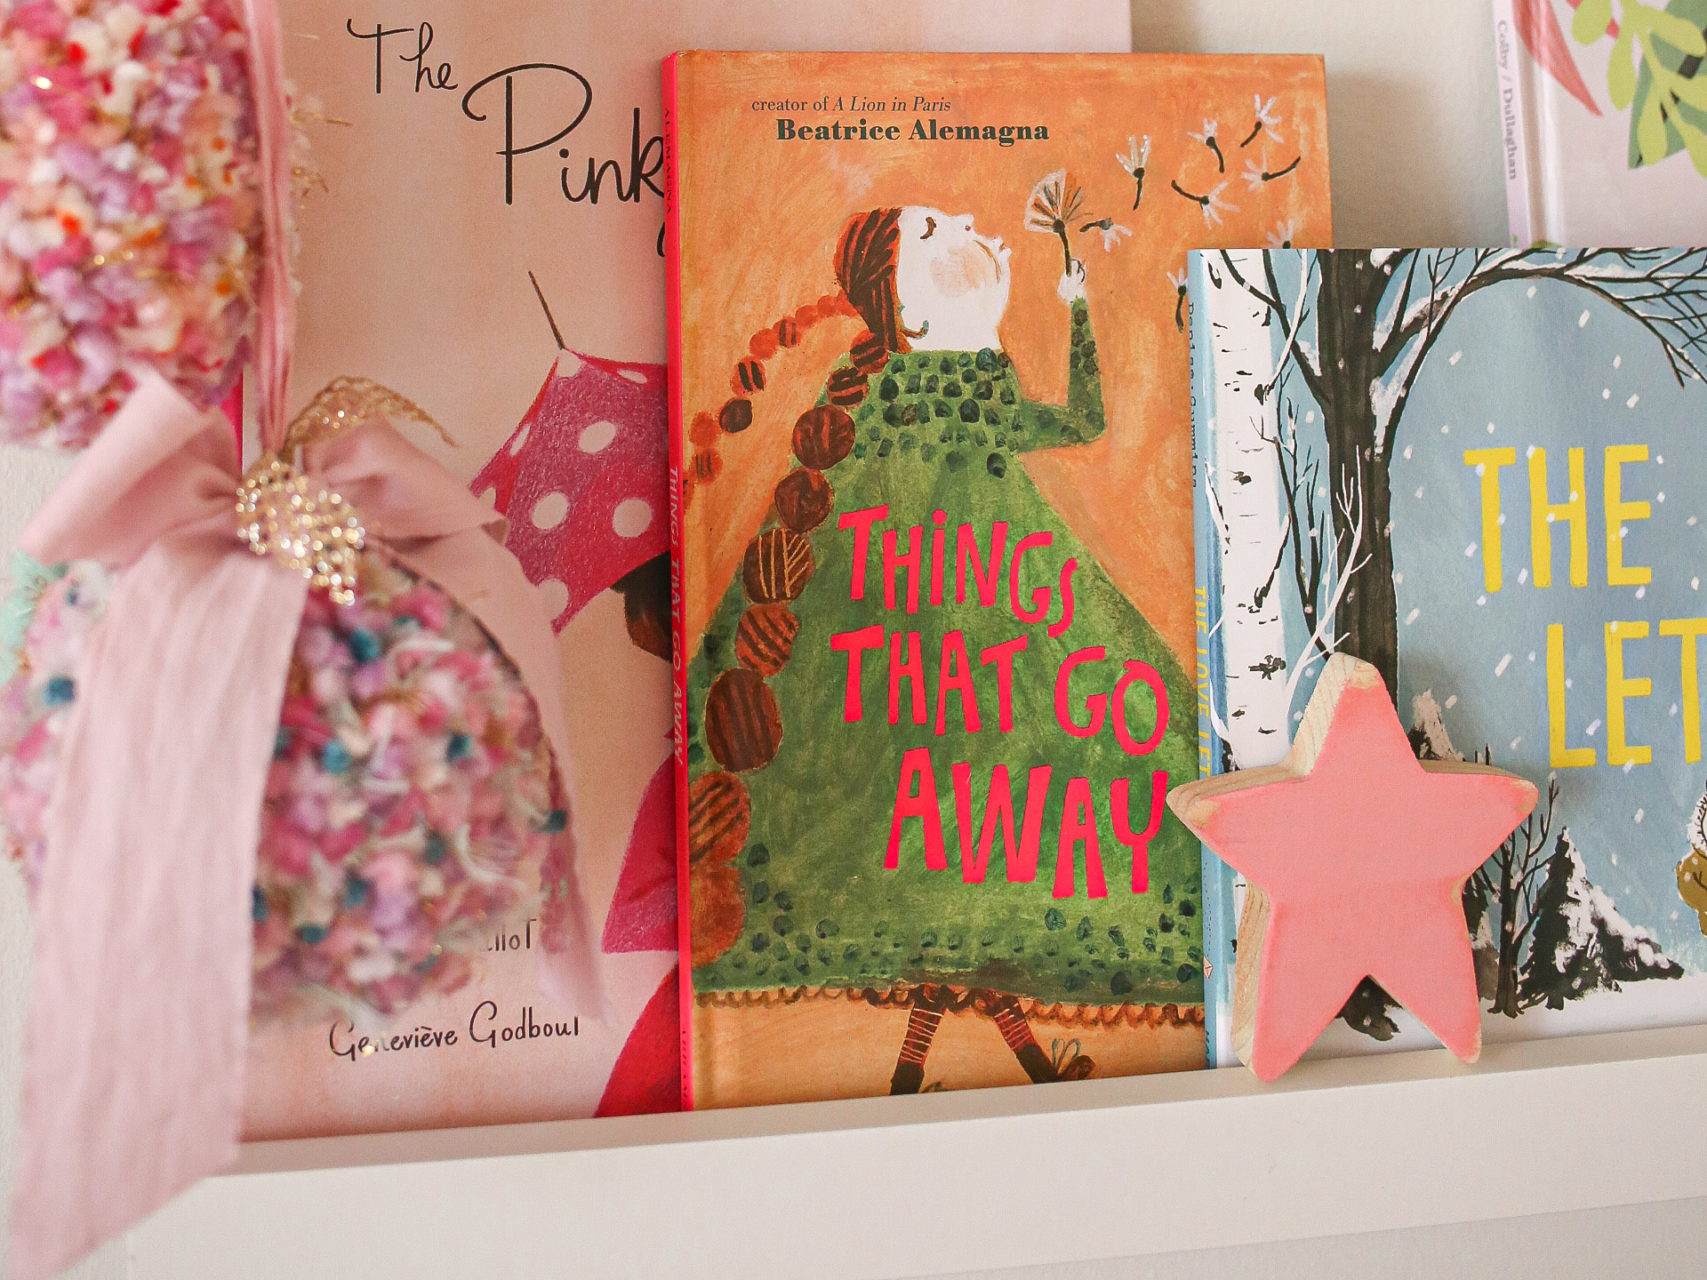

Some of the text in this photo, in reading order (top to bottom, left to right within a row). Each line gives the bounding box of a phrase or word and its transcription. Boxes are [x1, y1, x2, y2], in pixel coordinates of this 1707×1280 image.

[347, 18, 458, 93] The
[751, 96, 951, 111] creator of A Lion in Paris
[462, 63, 664, 205] Pink
[776, 118, 1050, 147] Beatrice Alemagna
[1464, 444, 1652, 592] THE
[668, 465, 684, 766] THINGS THAT GO AWAY
[830, 624, 1170, 756] THAT GO
[883, 747, 1169, 900] AWAY
